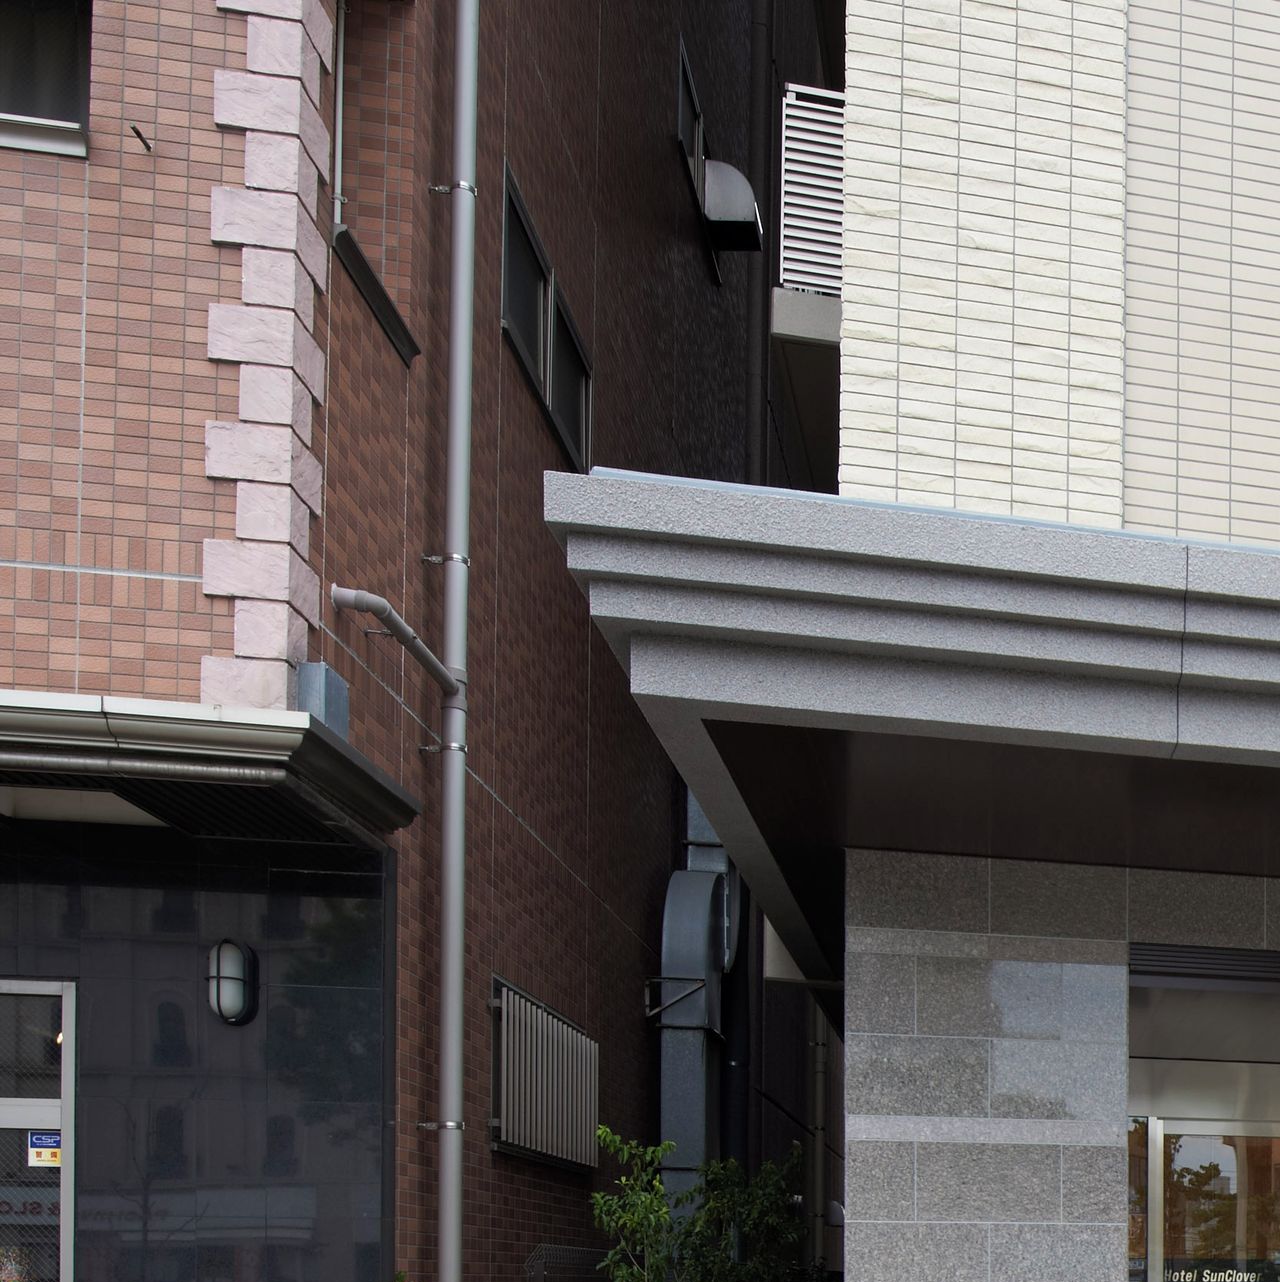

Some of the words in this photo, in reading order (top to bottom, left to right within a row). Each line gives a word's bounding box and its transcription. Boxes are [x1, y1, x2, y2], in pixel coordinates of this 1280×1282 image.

[32, 1135, 60, 1143] CSP
[1165, 1269, 1197, 1282] Hotel
[1202, 1269, 1262, 1282] SunClover
